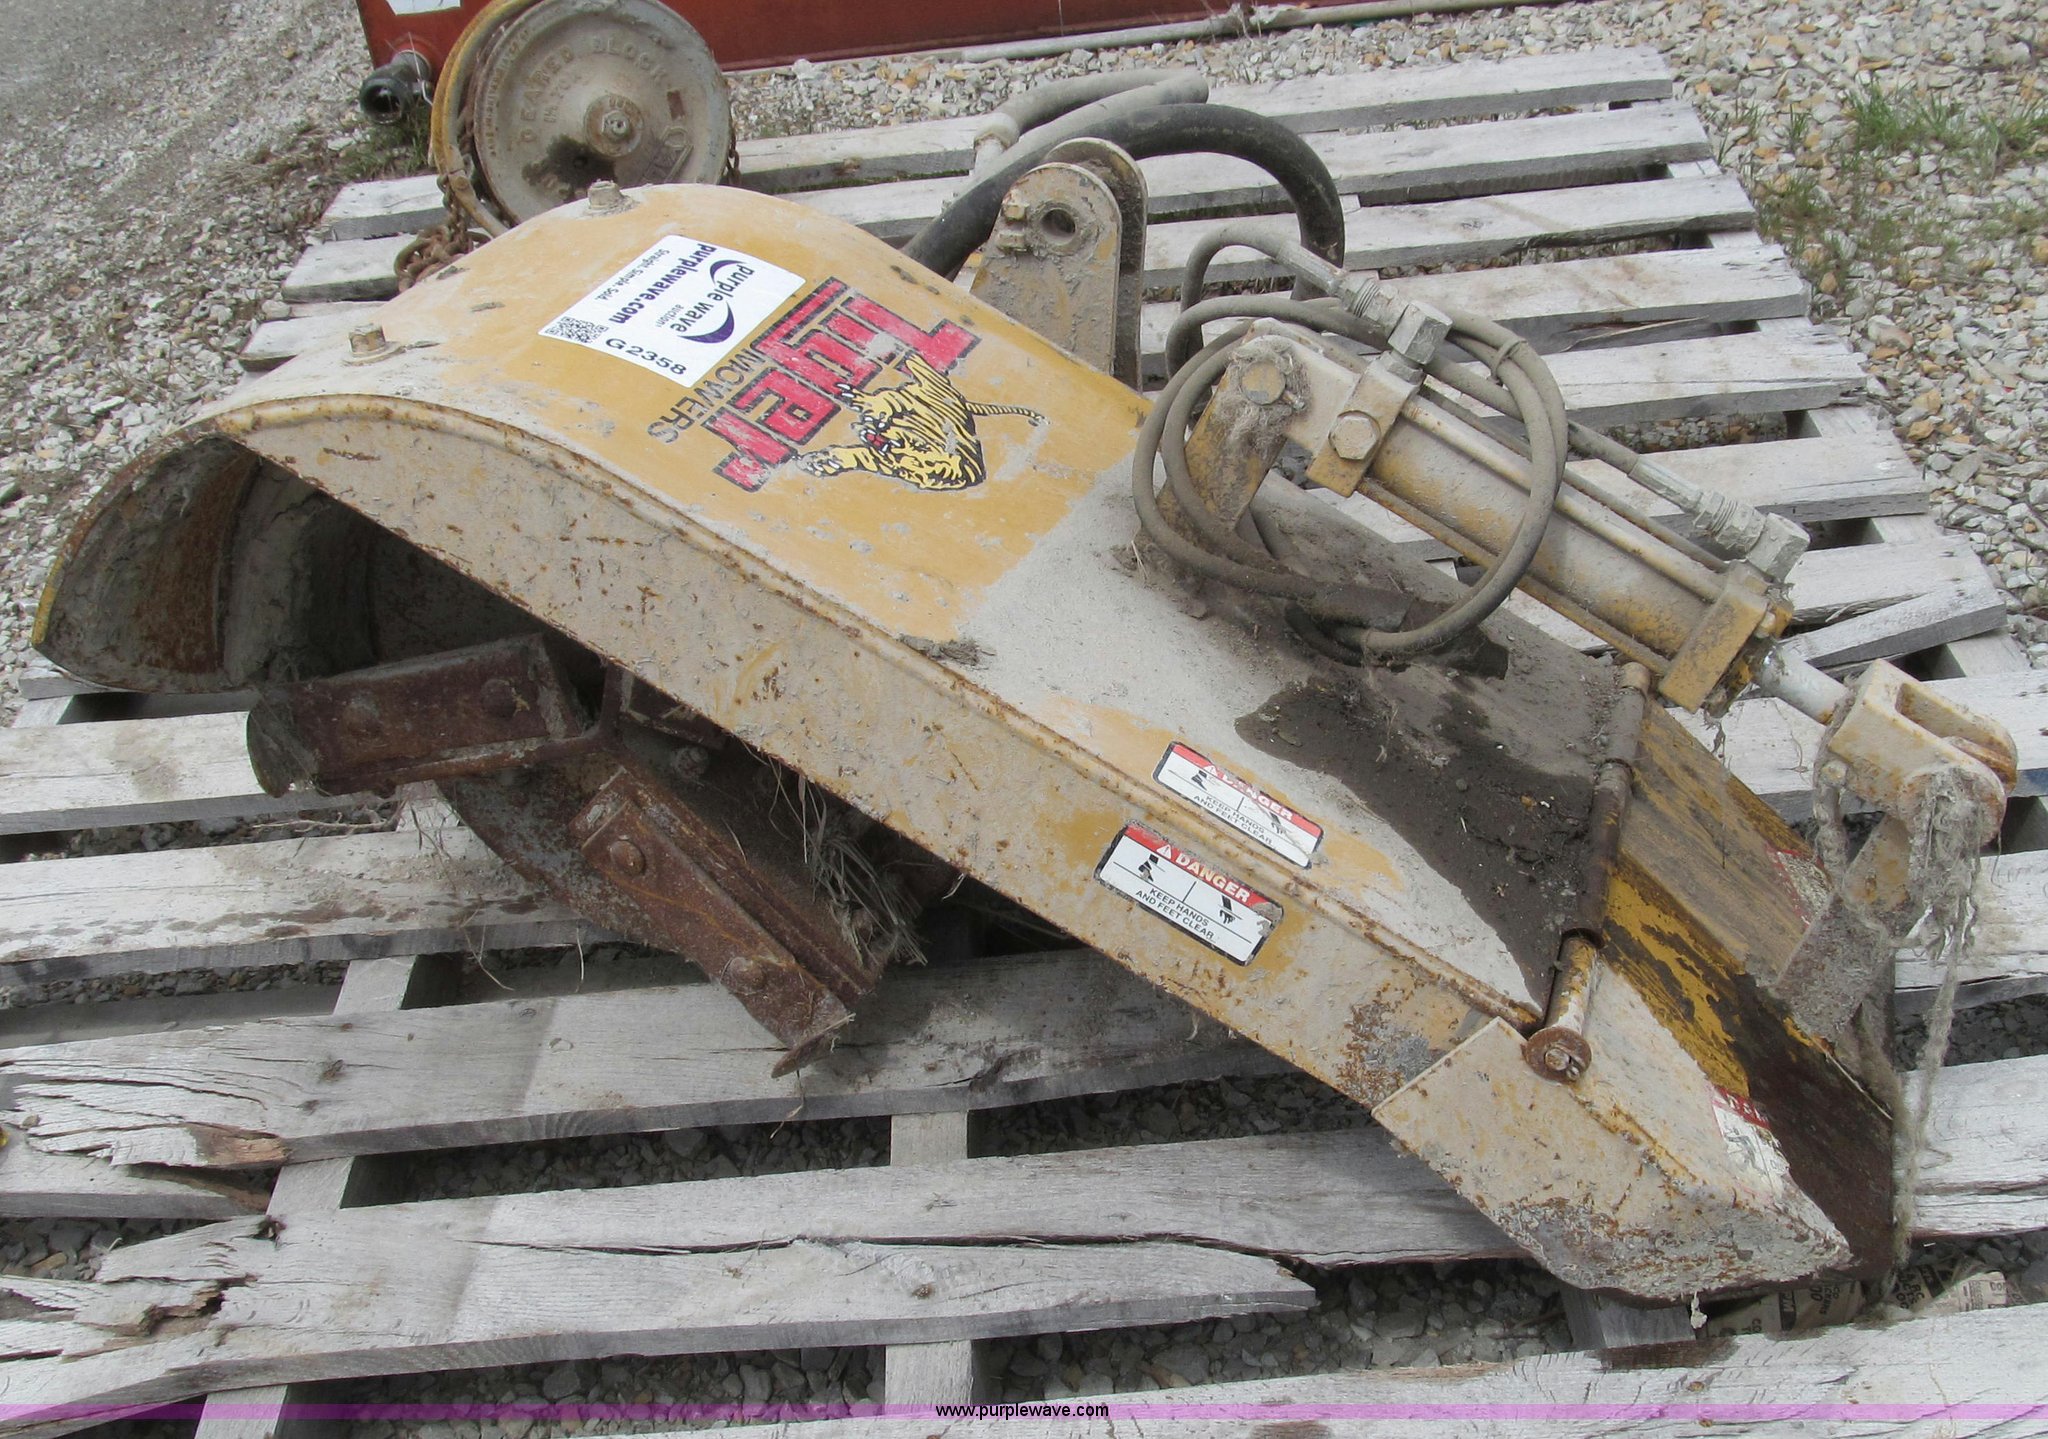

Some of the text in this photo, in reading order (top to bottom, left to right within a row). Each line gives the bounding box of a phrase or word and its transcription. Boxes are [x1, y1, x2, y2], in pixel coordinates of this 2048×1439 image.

[608, 243, 717, 324] purplewave.com
[670, 264, 754, 333] purple wave
[605, 338, 687, 375] G2358
[647, 347, 766, 444] MOWERS
[1193, 795, 1273, 845] AND FEET CLEAR
[1206, 796, 1265, 834] KEEP HANDS
[1176, 852, 1250, 902] DANGER
[1135, 889, 1215, 939] AND FEET CLEAR
[1149, 888, 1210, 927] KEEP HANDS
